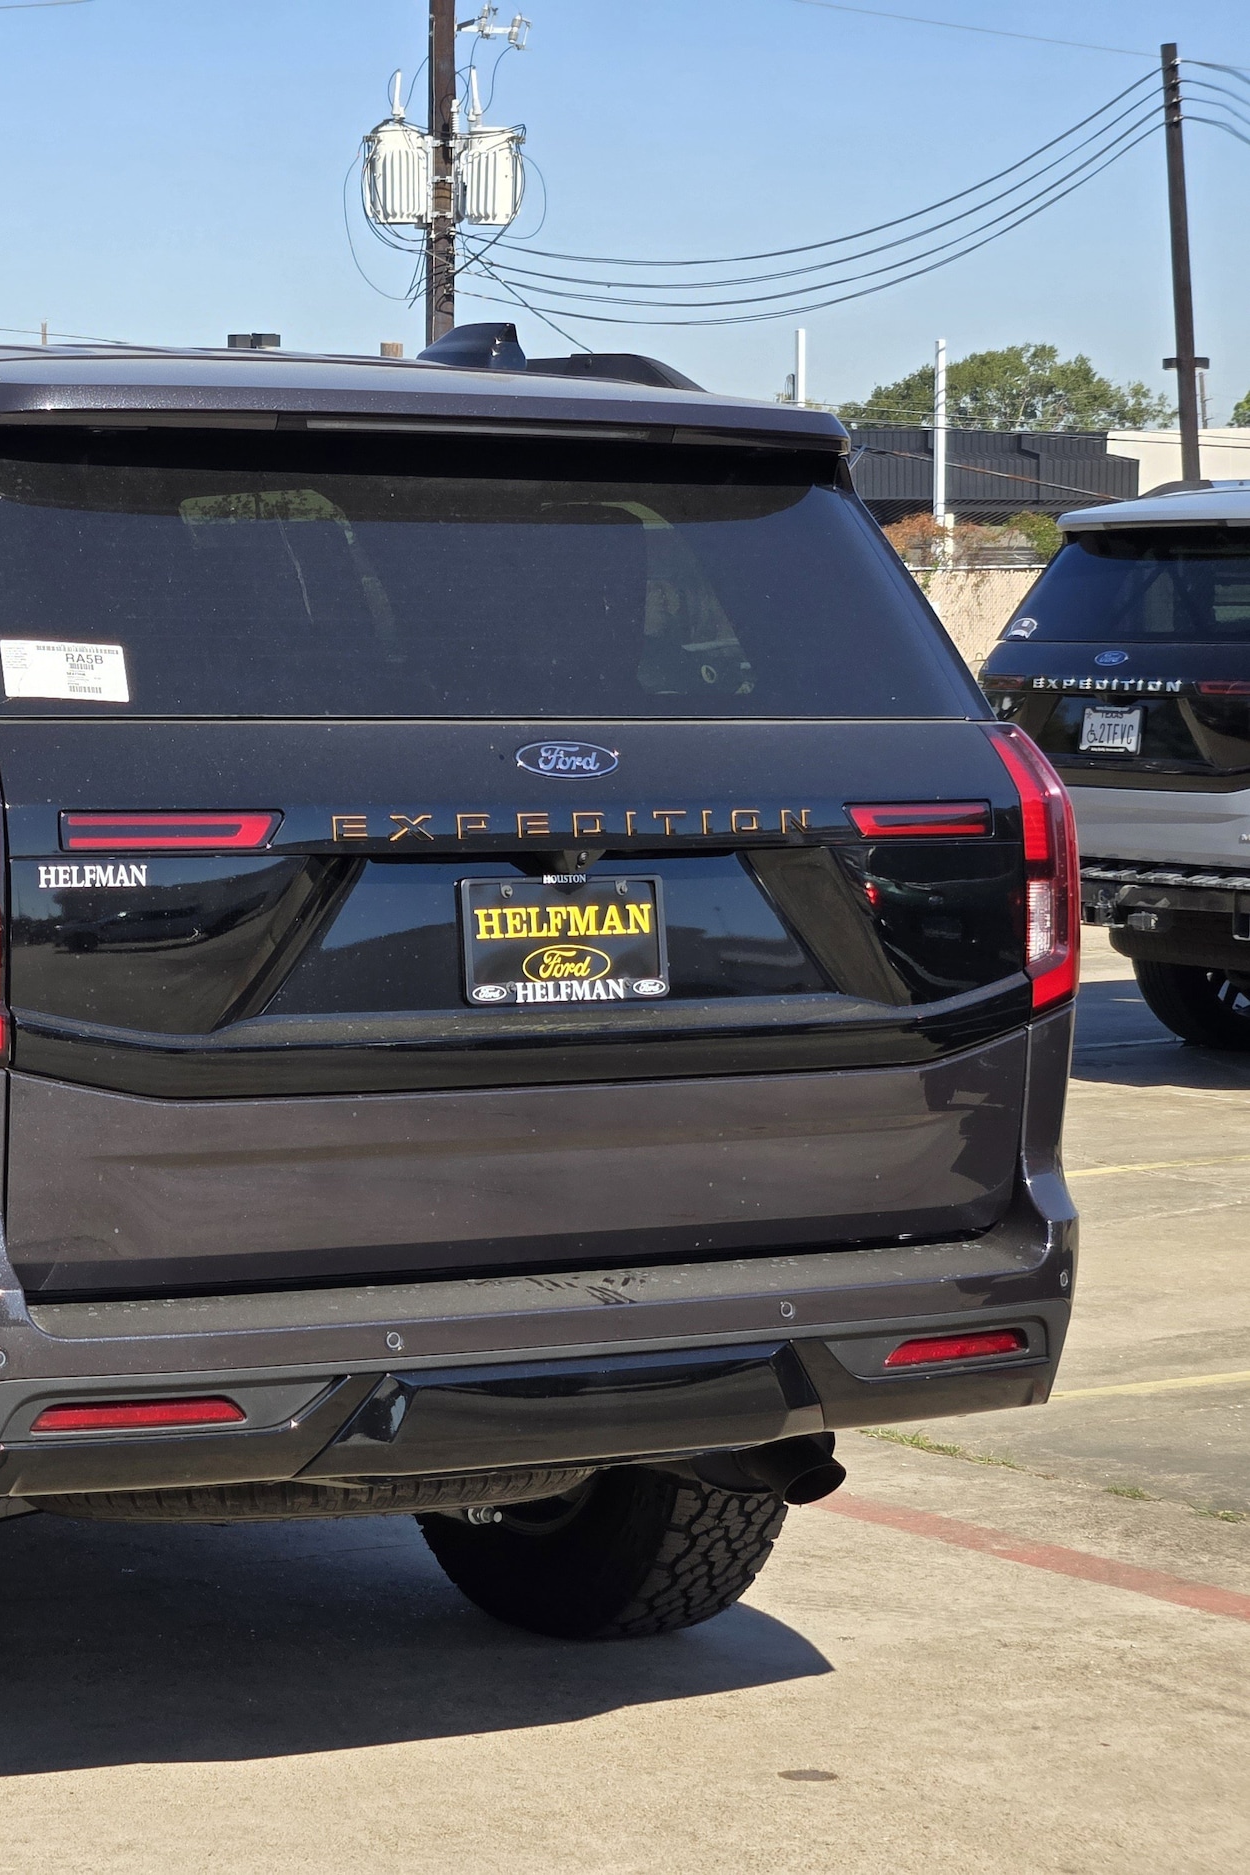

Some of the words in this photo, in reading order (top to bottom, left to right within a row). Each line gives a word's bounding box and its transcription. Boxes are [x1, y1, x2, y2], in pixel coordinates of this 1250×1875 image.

[65, 653, 104, 664] RA5B
[1033, 678, 1182, 692] EXPEDITION
[538, 745, 600, 771] Ford
[331, 808, 812, 842] EXPEDITION
[37, 865, 148, 889] HELFMAN
[542, 874, 587, 885] HOUSTON
[473, 903, 652, 940] HELFMAN
[538, 949, 592, 979] Ford
[515, 978, 625, 1004] HELFMAN
